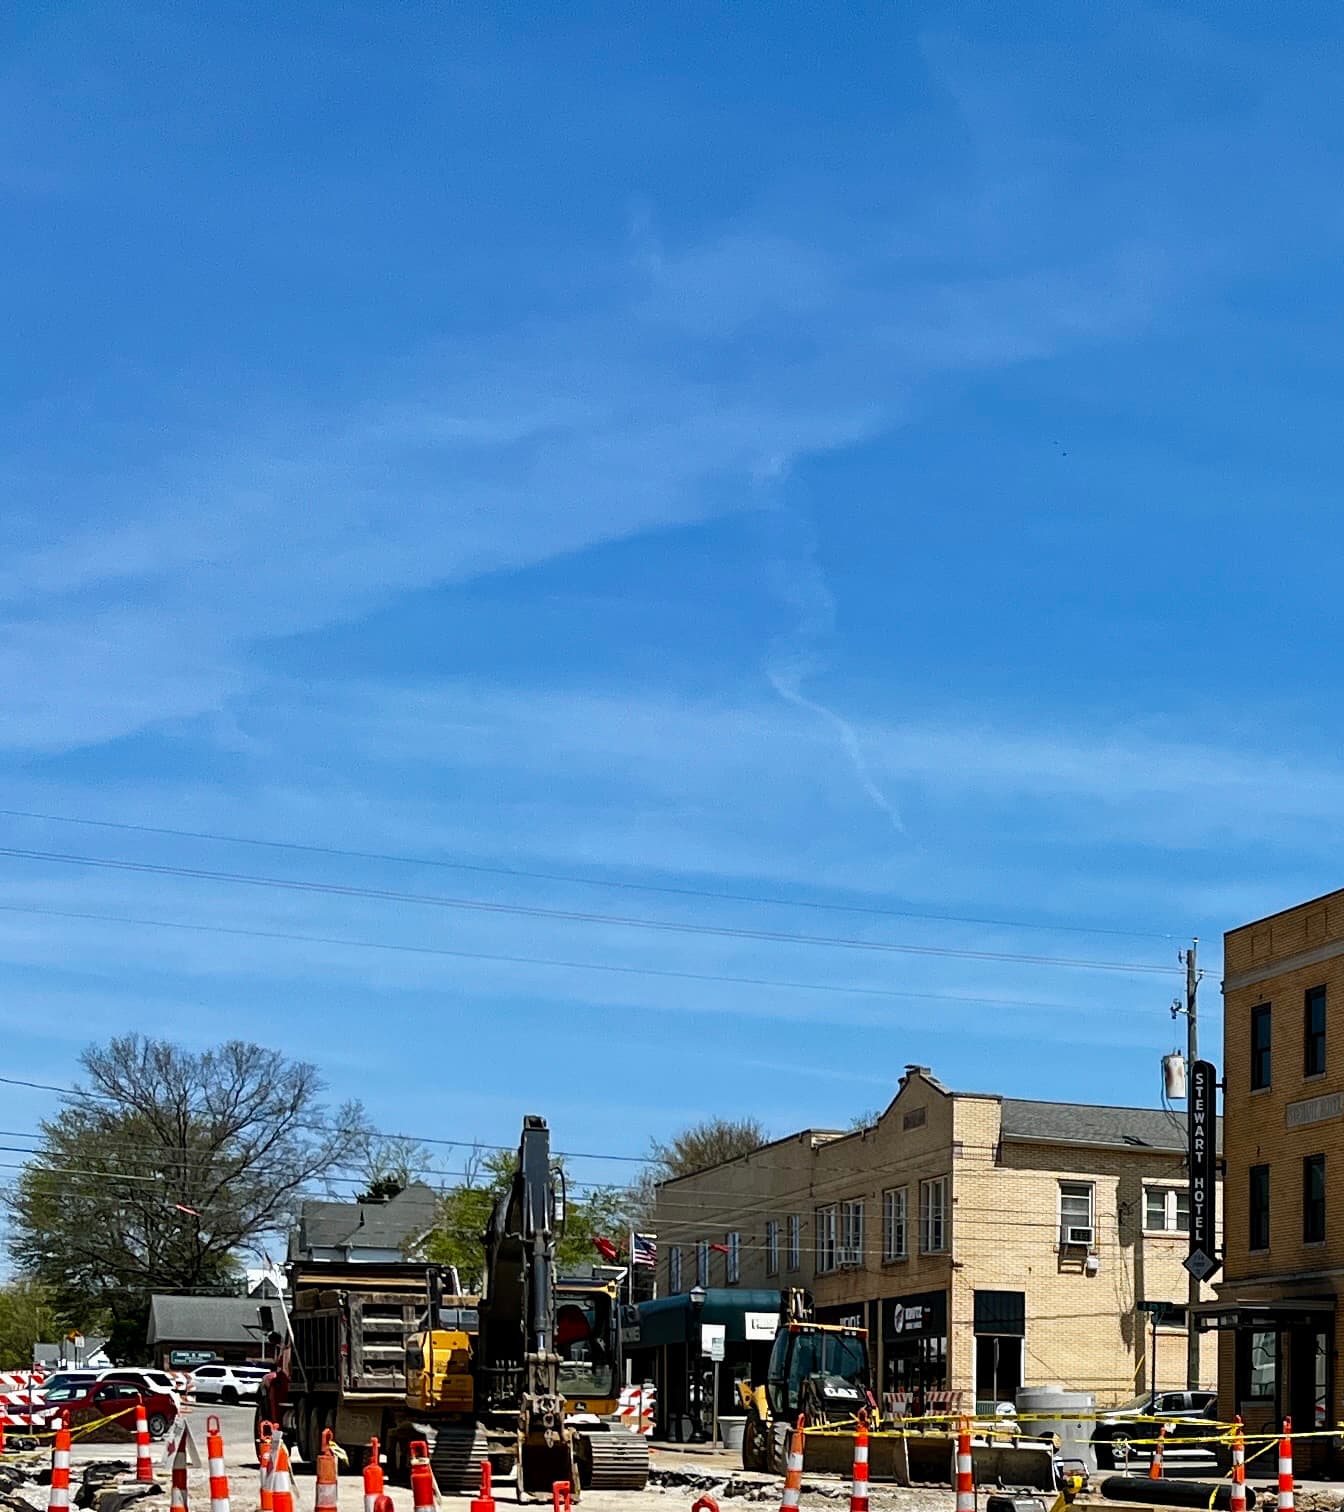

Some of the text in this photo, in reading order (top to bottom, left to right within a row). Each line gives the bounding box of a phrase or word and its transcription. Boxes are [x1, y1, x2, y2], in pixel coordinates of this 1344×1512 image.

[1194, 1072, 1205, 1164] STEWART
[1194, 1177, 1205, 1241] HOTEL
[824, 1387, 858, 1399] CAT
